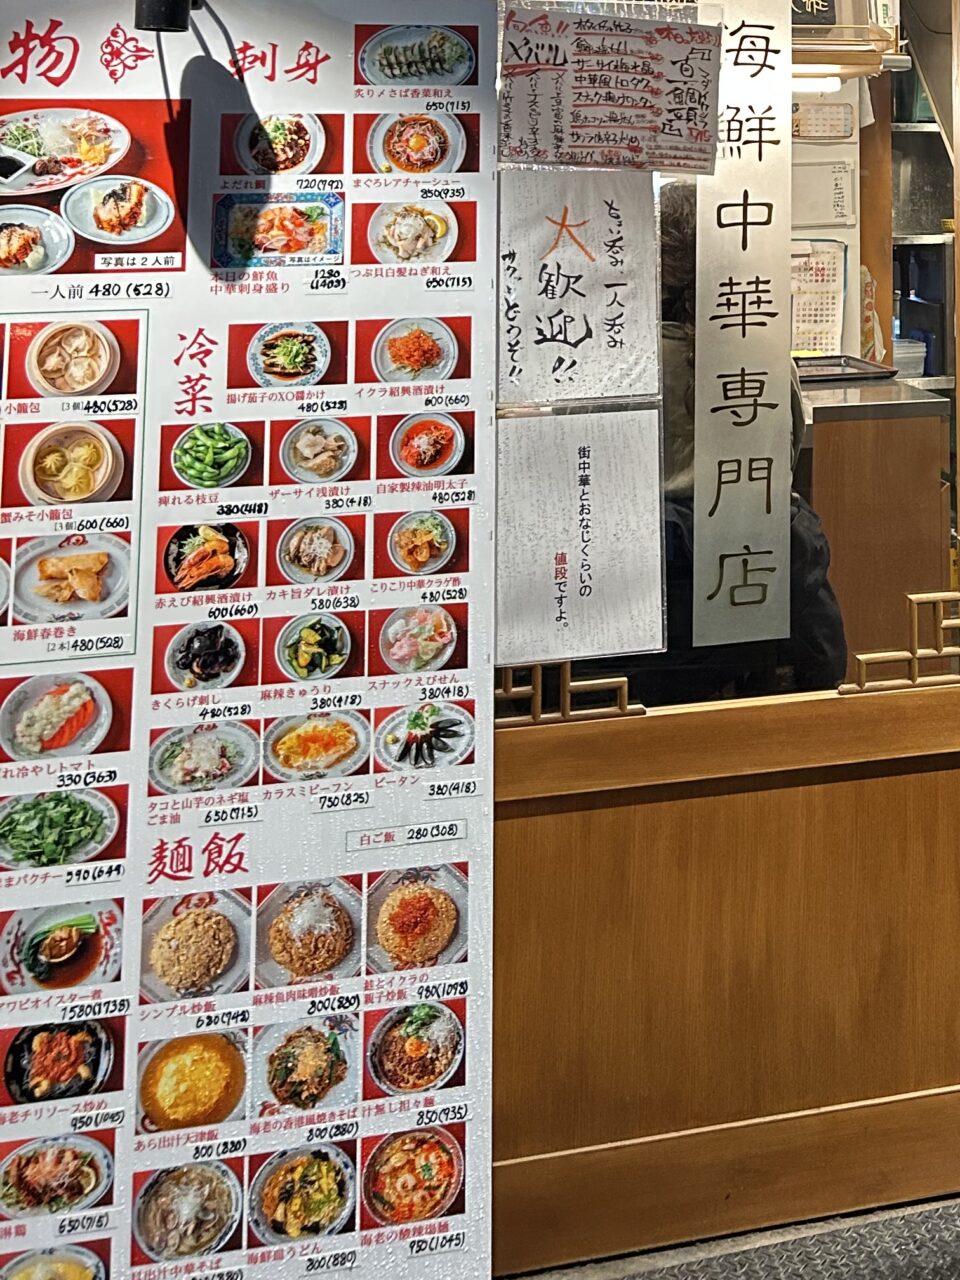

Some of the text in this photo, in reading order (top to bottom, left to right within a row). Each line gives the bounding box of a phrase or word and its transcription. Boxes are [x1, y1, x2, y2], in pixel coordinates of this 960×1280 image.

[0, 19, 80, 88] 物
[228, 41, 332, 85] 刺身
[425, 101, 471, 112] 650(715)
[296, 179, 344, 190] 720(792)
[353, 177, 461, 189] まぐろレアチャーシュー
[421, 188, 465, 200] 850(935)
[100, 256, 175, 267] 写真は2人前
[289, 255, 341, 263] 写真はイメージ
[210, 271, 278, 282] 本日の鮮魚
[426, 276, 472, 289] 650(715)
[31, 284, 83, 300] 一人前
[209, 283, 291, 296] 中華刺身盛り
[707, 20, 781, 607] 海鮮中華専門店
[173, 327, 219, 417] 冷菜
[355, 384, 446, 399] イクラ紹興酒漬け
[424, 394, 470, 407] 600(660)
[269, 485, 351, 500] ザーサイ浅漬け
[325, 495, 372, 509] 380(418)
[77, 516, 129, 532] 600(660)
[577, 446, 593, 597] 街中華とおなじくらいの
[370, 576, 461, 593] こりこり中華クラゲ酢
[554, 551, 569, 628] 値段ですよ。
[154, 591, 253, 609] 赤えび紹興酒漬け
[311, 595, 360, 611] 580(638)
[421, 587, 468, 603] 480(528)
[12, 625, 77, 642] 海鮮春巻き
[71, 636, 124, 652] 480(528)
[368, 673, 460, 691] スナックえびせん
[260, 684, 332, 701] 麻辣きゅうり
[419, 685, 470, 702] 380(418)
[151, 694, 221, 711] きくらげ刺し
[0, 759, 95, 778] れ冷やしトマト
[148, 792, 249, 812] タコと山芋のネギ塩
[147, 813, 181, 826] ごま油
[360, 831, 396, 845] 白ご飯
[140, 1000, 216, 1021] シンプル炒飯
